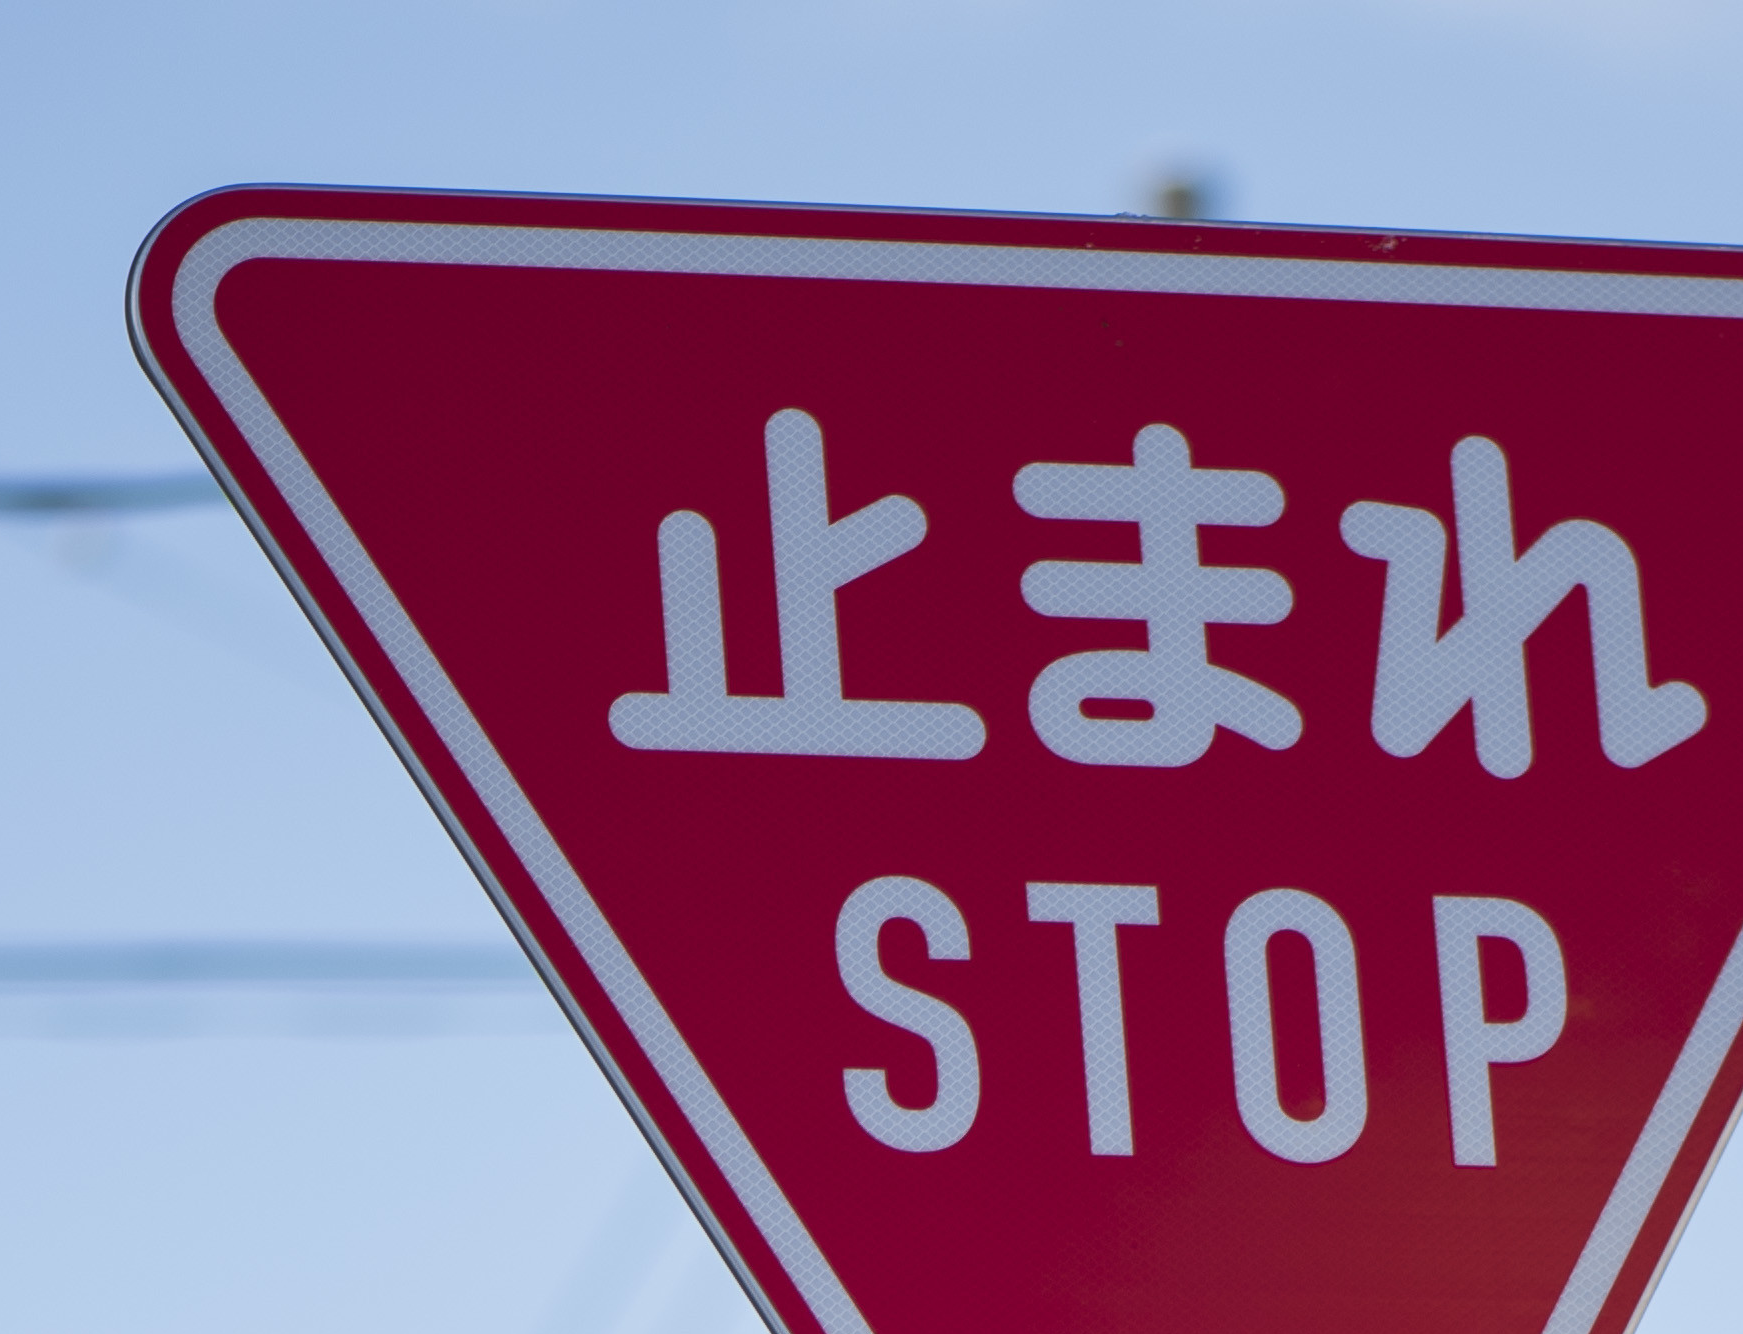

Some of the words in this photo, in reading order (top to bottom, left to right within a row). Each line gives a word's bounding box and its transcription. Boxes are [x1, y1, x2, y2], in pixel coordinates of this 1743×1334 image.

[607, 407, 1708, 779] 止まれ
[834, 875, 1568, 1167] STOP
